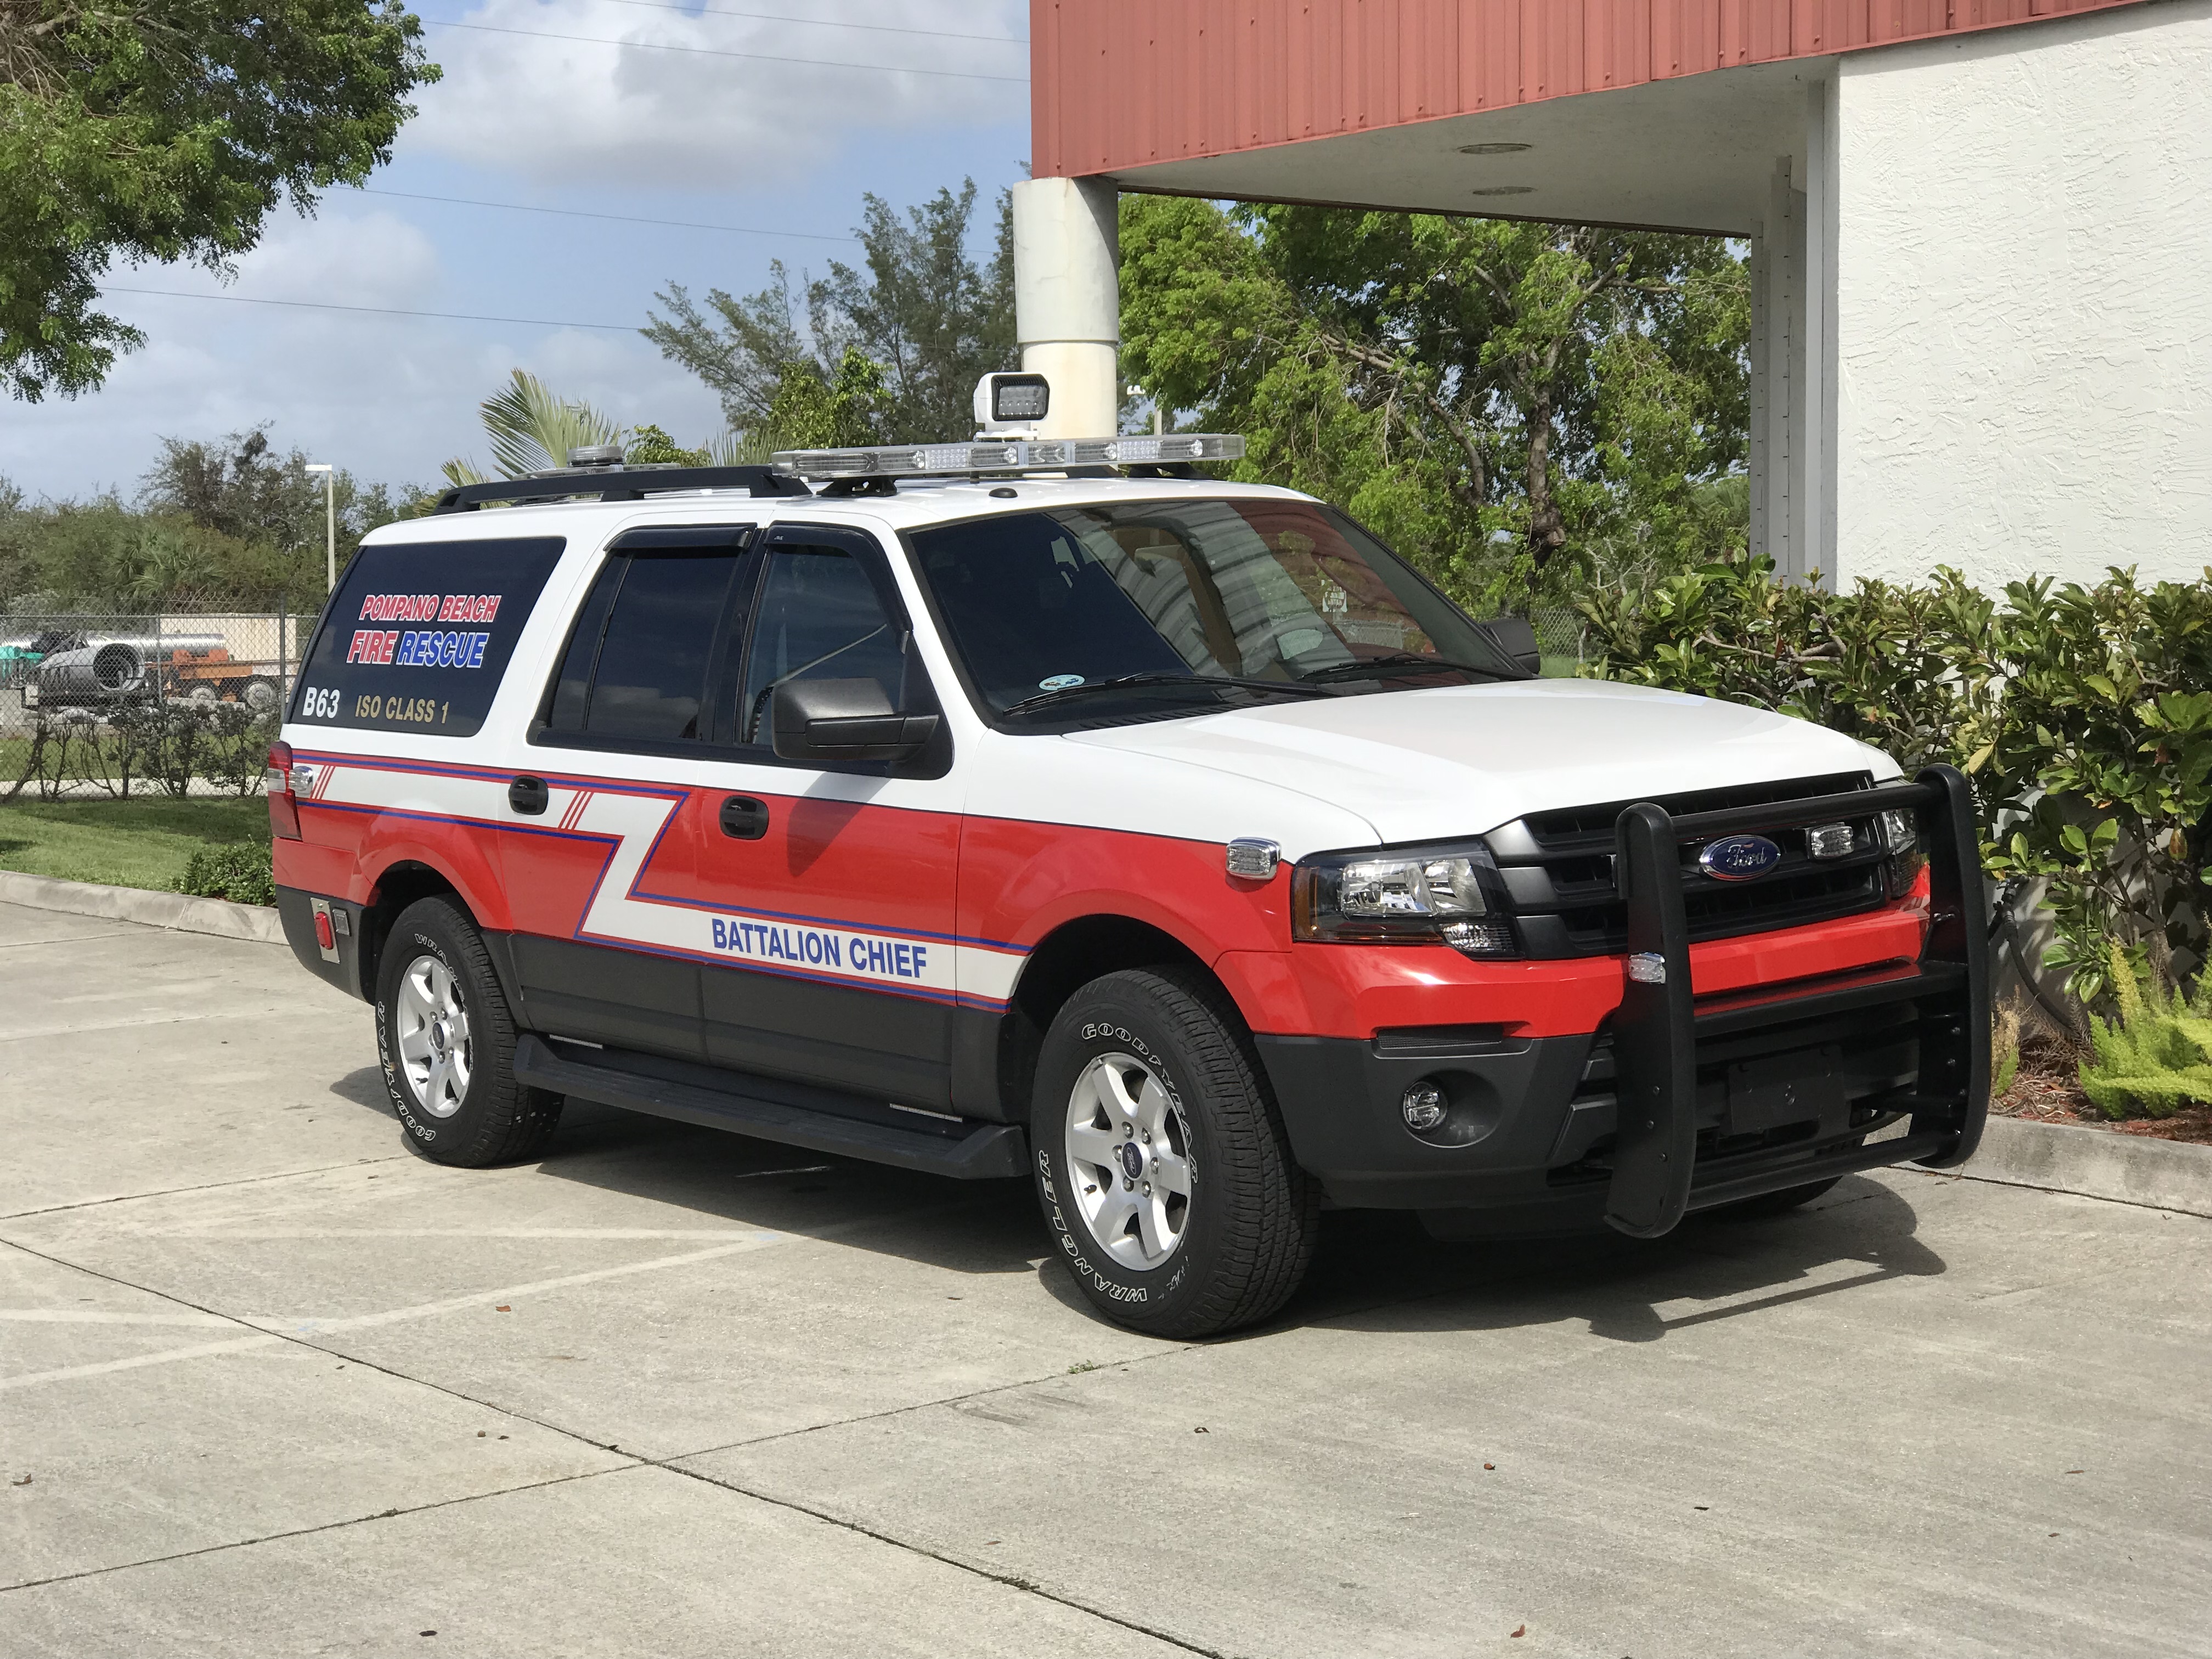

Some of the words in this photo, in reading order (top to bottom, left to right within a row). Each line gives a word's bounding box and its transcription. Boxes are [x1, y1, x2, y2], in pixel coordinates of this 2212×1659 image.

[358, 594, 439, 622] POMPANO
[438, 595, 502, 623] BEACH
[346, 630, 399, 665] FIRE
[396, 631, 490, 669] RESCUE
[302, 687, 340, 719] B63
[355, 695, 381, 718] ISO
[386, 696, 435, 723] CLASS
[441, 701, 449, 724] 1
[1727, 843, 1767, 868] Ford
[712, 918, 841, 967] BATTALION
[849, 938, 927, 978] CHIEF
[377, 1001, 436, 1142] GOODYEAR
[1081, 1023, 1198, 1184] GOODYEAR
[1039, 1149, 1148, 1302] WRANGLER
